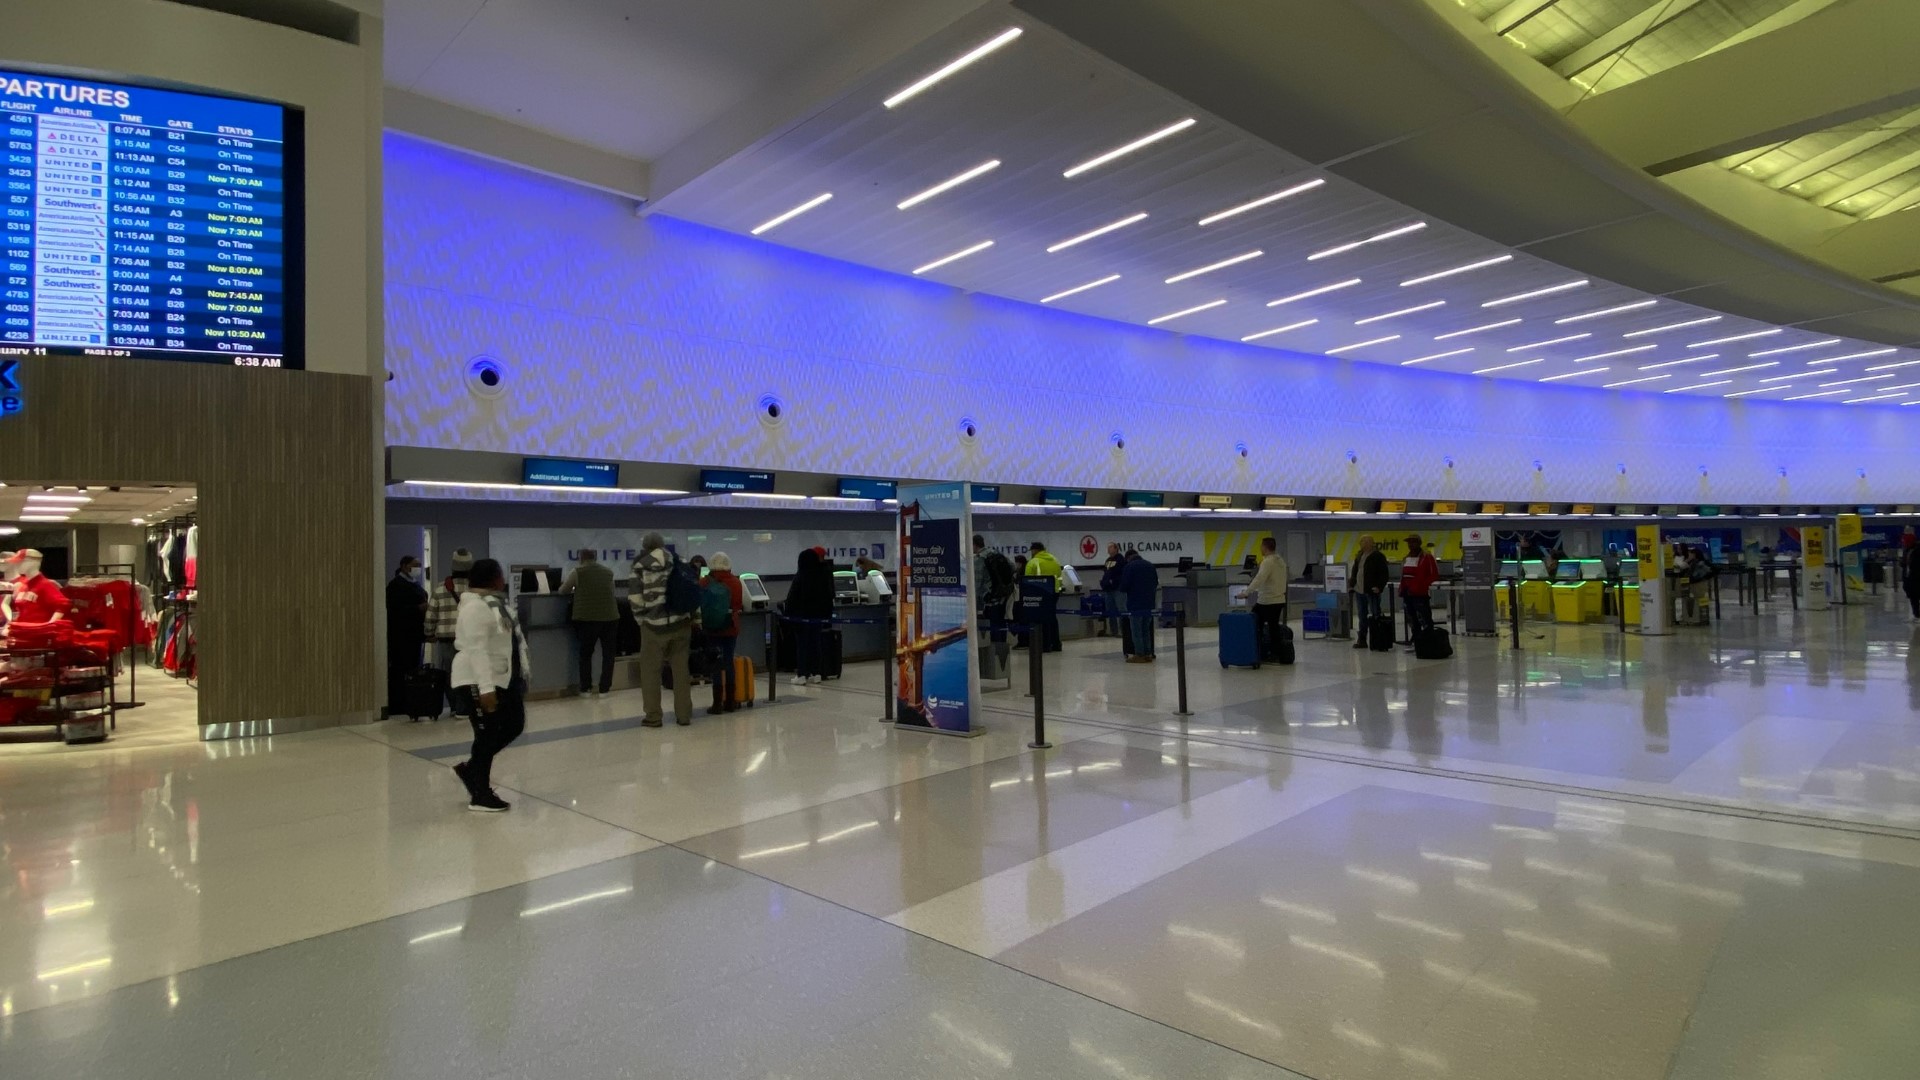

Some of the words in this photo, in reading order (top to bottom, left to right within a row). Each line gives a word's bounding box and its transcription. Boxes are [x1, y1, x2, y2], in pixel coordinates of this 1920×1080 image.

[1, 101, 37, 111] FLIGHT
[53, 106, 93, 117] AIRLINE
[120, 114, 142, 123] TIME
[167, 120, 193, 129] GATE
[218, 126, 253, 136] STATUS
[60, 133, 98, 144] DELTA
[114, 139, 134, 147] 9:15
[168, 145, 185, 153] C54
[233, 152, 253, 160] Time
[114, 126, 134, 134] 8:07
[168, 132, 185, 140] B21
[218, 138, 231, 146] On
[233, 139, 253, 148] Time
[60, 146, 98, 156] DELTA
[114, 152, 138, 160] 11:13
[139, 154, 154, 162] AM
[168, 158, 185, 166] C54
[233, 165, 253, 173] Time
[45, 160, 89, 168] UNITED
[114, 165, 134, 173] 6:00
[135, 167, 150, 175] AM
[208, 175, 227, 183] Now
[229, 177, 247, 185] 7:00
[248, 178, 262, 186] AM
[8, 169, 31, 177] 3423
[44, 172, 89, 181] UNITED
[114, 178, 134, 186] 8:12
[135, 180, 150, 188] AM
[168, 184, 185, 192] B32
[218, 189, 231, 197] On
[233, 190, 253, 199] Time
[44, 186, 89, 195] UNITED
[139, 193, 154, 201] AM
[168, 197, 185, 205] B32
[233, 203, 253, 211] Time
[10, 196, 28, 204] 557
[44, 198, 96, 210] Southwest
[114, 205, 134, 213] 5:45
[208, 213, 227, 221] Now
[229, 215, 247, 223] 7:00
[248, 216, 262, 225] AM
[7, 223, 30, 231] 5319
[114, 231, 138, 240] 11:15
[139, 233, 154, 241] AM
[167, 236, 184, 244] B20
[218, 240, 231, 248] On
[233, 242, 253, 250] Time
[114, 218, 133, 226] 6:03
[168, 223, 185, 231] B22
[208, 226, 227, 234] Now
[229, 228, 247, 236] 7:30
[248, 229, 262, 237] AM
[7, 250, 30, 258] 1102
[43, 253, 87, 261] UNITED
[134, 259, 149, 267] AM
[208, 265, 227, 273] Now
[229, 267, 247, 275] 8:00
[248, 268, 262, 276] AM
[114, 244, 133, 252] 7:14
[134, 246, 149, 254] AM
[218, 253, 231, 261] On
[233, 254, 253, 262] Time
[43, 265, 96, 276] Southwest
[114, 271, 133, 279] 9:00
[233, 280, 253, 288] Time
[8, 278, 26, 286] 572
[43, 279, 96, 289] Southwest
[114, 284, 133, 292] 7:00
[208, 290, 227, 298] Now
[229, 292, 247, 300] 7:45
[248, 293, 262, 301] AM
[5, 305, 29, 313] 4035
[113, 310, 133, 318] 7:03
[233, 318, 253, 326] Time
[208, 303, 227, 311] Now
[229, 305, 247, 313] 7:00
[248, 306, 262, 314] AM
[134, 325, 149, 333] AM
[227, 330, 249, 338] 10:50
[251, 331, 265, 339] AM
[113, 337, 138, 345] 10:33
[139, 338, 154, 346] AM
[218, 342, 231, 350] On
[233, 344, 253, 352] Time
[34, 347, 46, 355] 11
[234, 357, 259, 367] 6:38
[261, 357, 281, 367] AM
[925, 492, 950, 500] UNITED
[568, 549, 642, 561] UITE
[824, 547, 868, 557] NITED
[913, 546, 927, 554] New
[930, 545, 945, 555] daily
[987, 546, 1028, 554] NITED
[1117, 542, 1134, 551] AIR
[1137, 542, 1183, 551] CANADA
[913, 556, 939, 564] nonstop
[928, 576, 957, 584] Francisco
